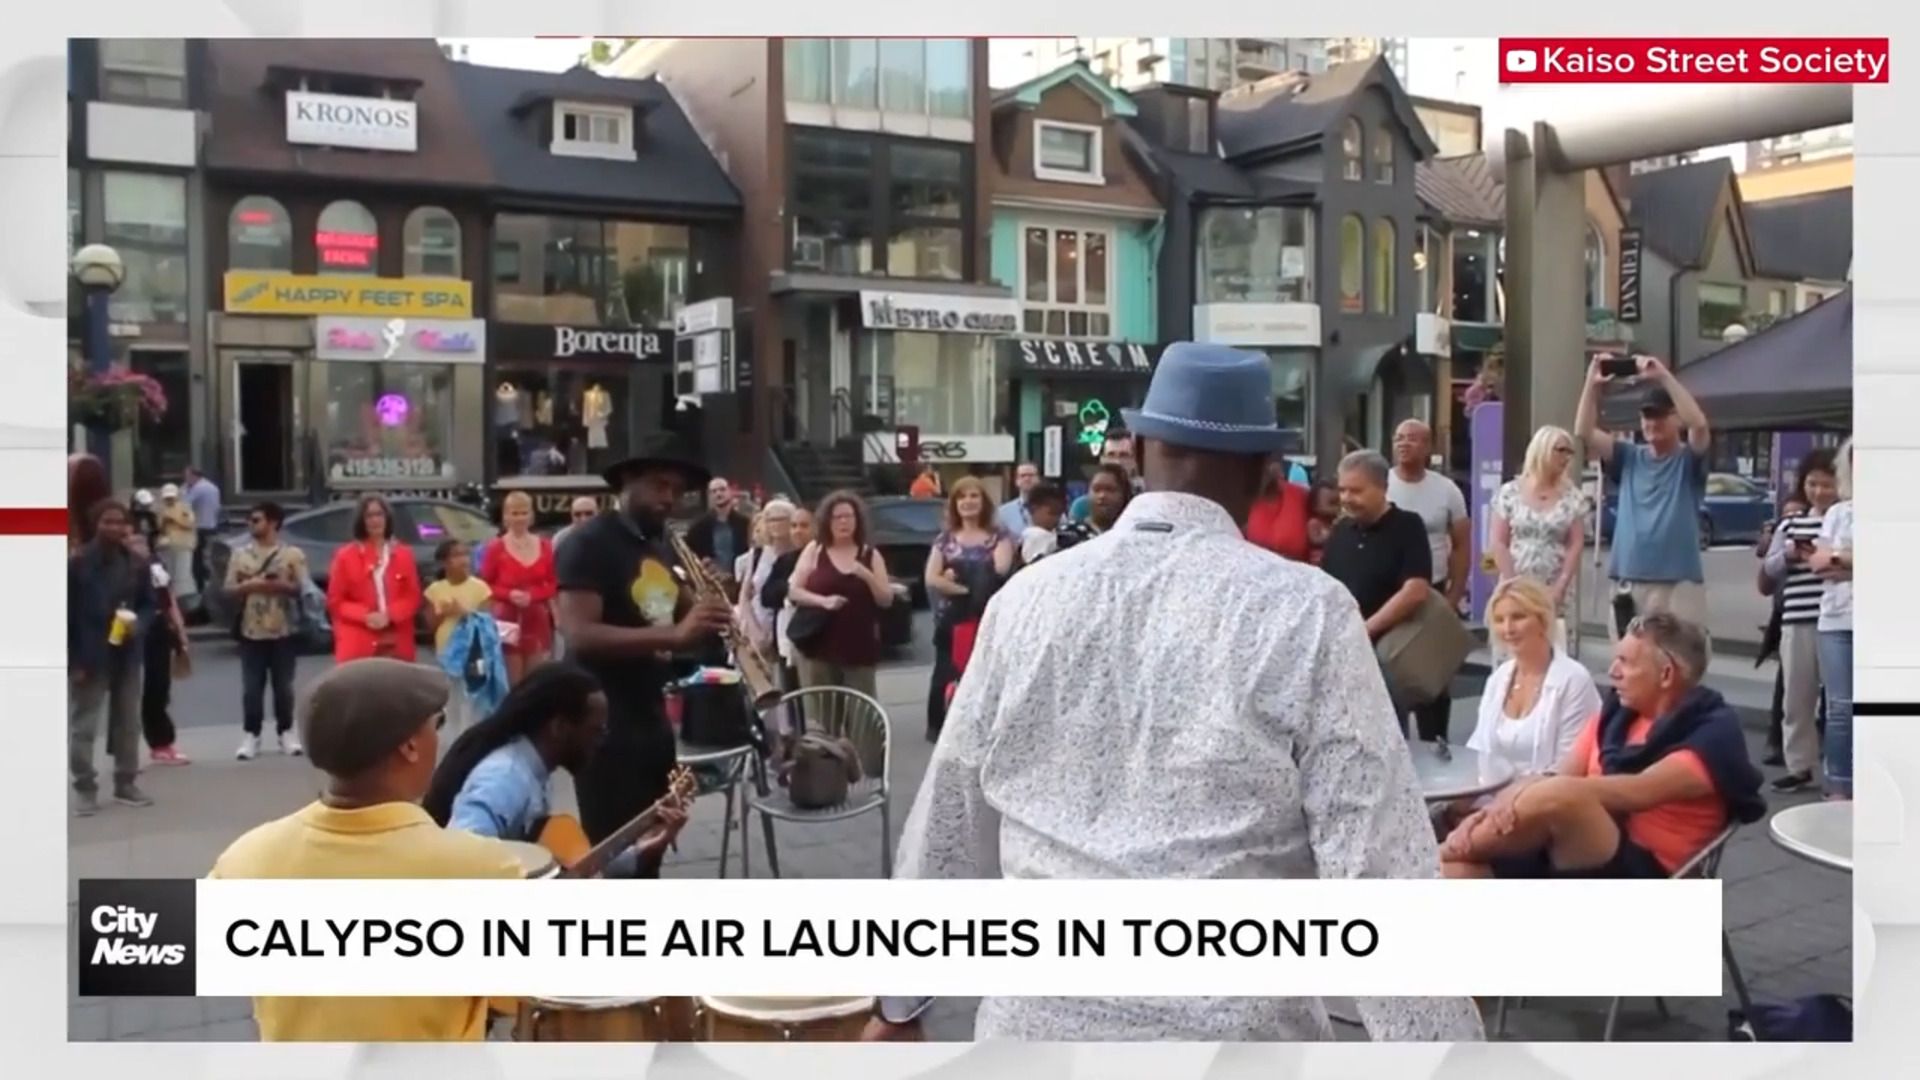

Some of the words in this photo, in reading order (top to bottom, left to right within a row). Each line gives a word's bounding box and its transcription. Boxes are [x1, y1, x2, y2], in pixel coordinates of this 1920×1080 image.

[295, 101, 410, 129] KRONOS
[274, 286, 353, 305] HAPPY
[359, 289, 415, 306] FEET
[421, 291, 465, 308] SPA
[555, 326, 662, 360] Borenta
